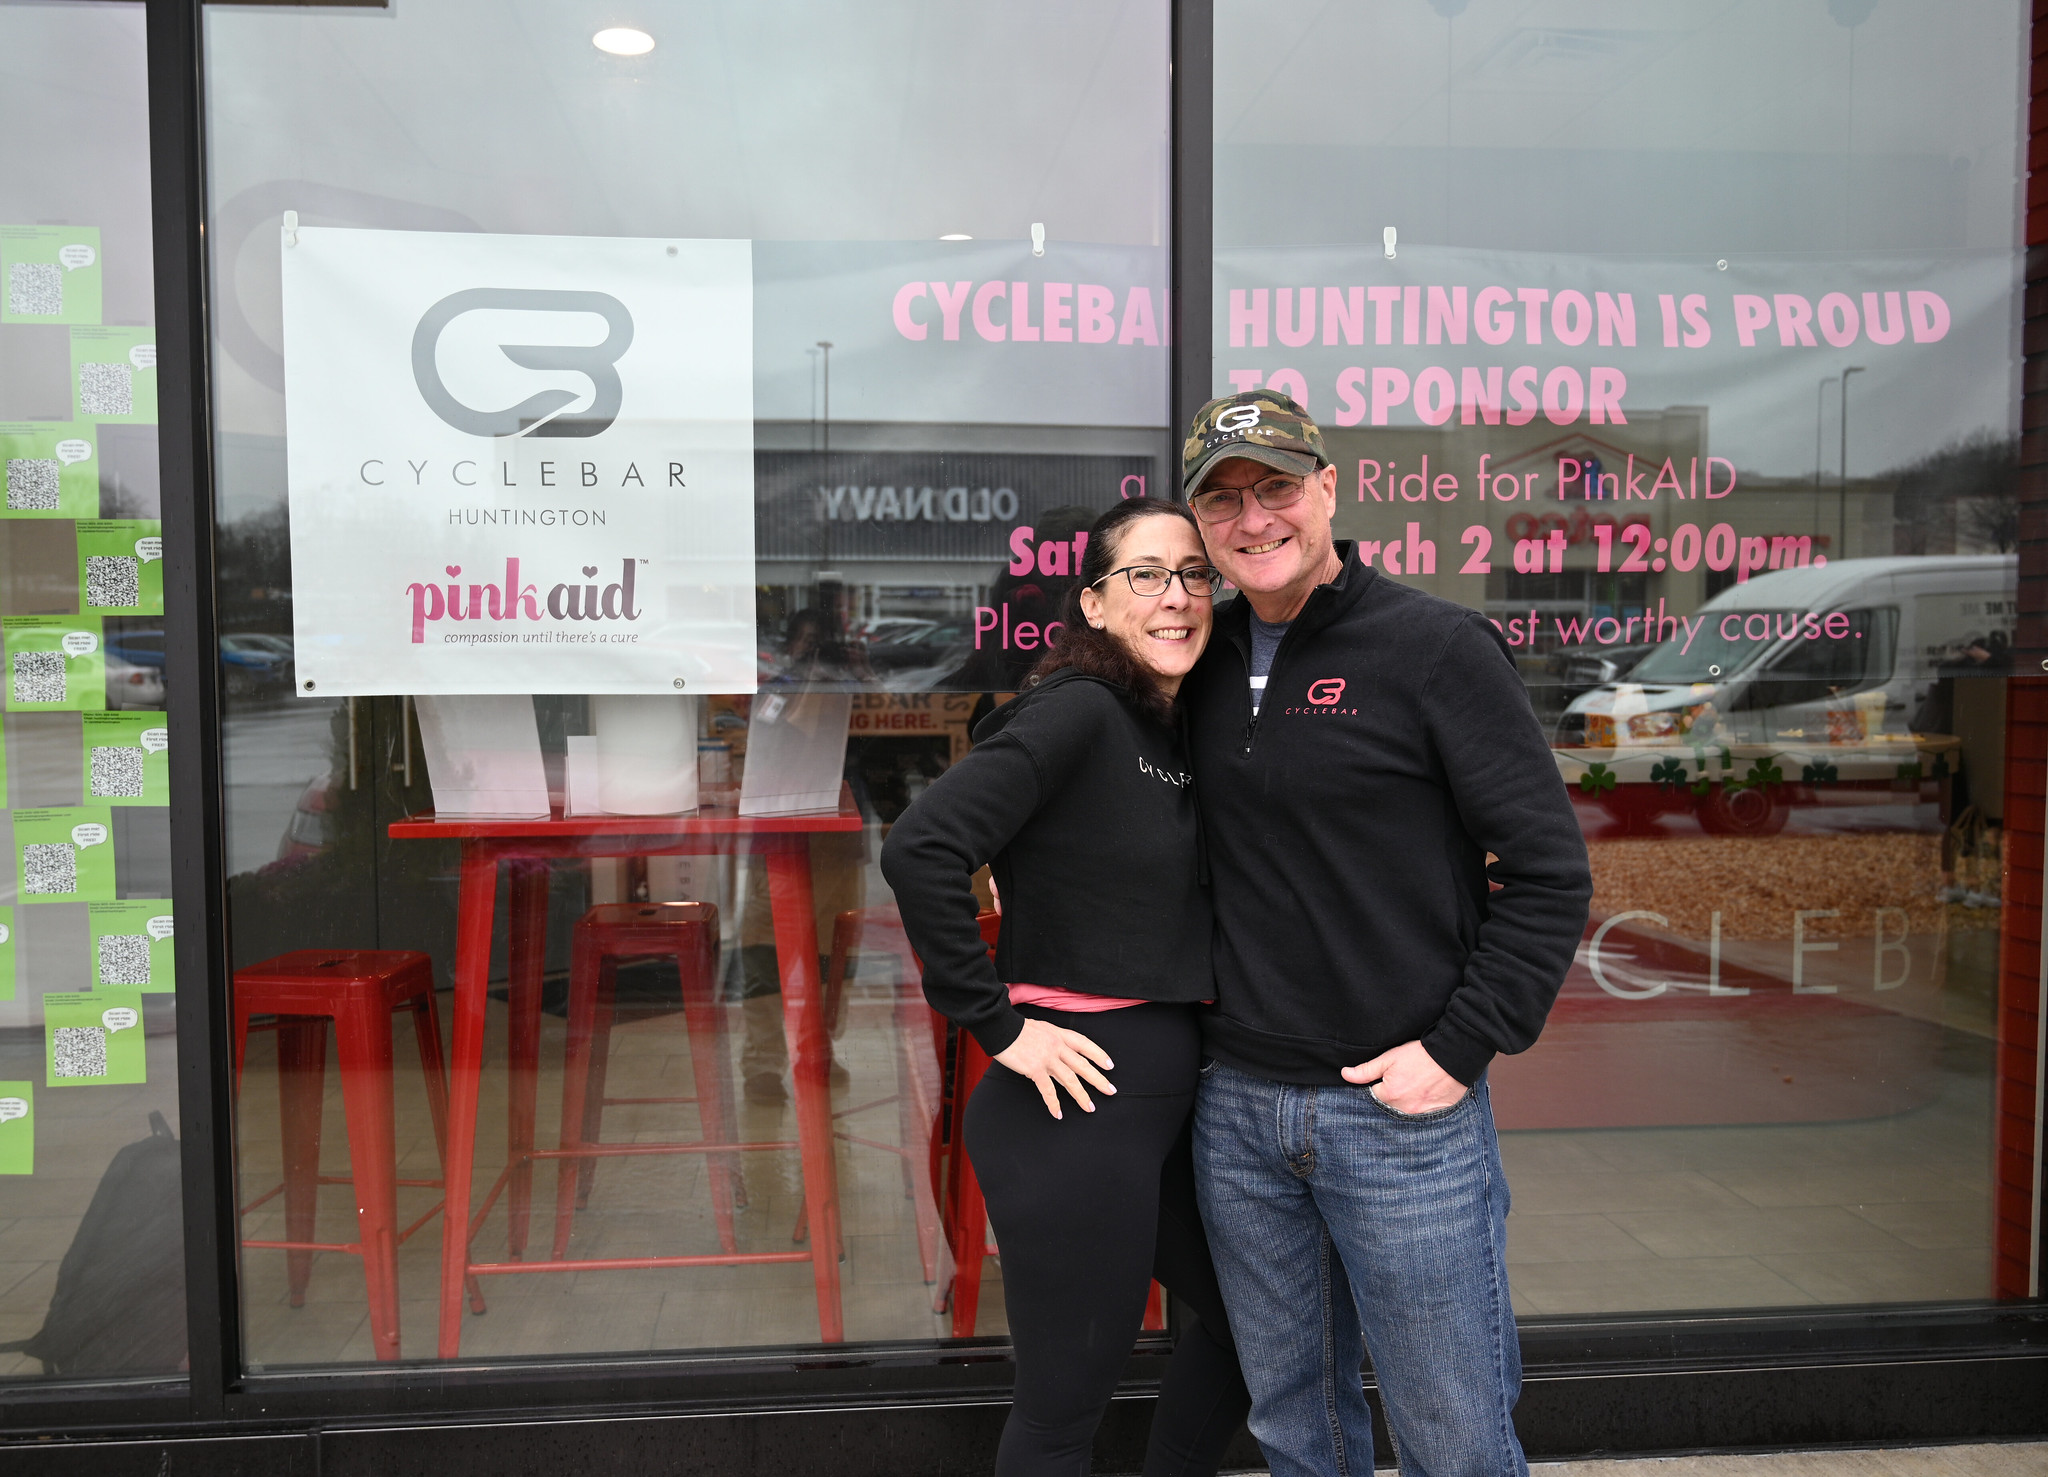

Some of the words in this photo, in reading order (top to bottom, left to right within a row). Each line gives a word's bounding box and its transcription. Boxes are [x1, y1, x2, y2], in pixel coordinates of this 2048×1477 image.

[893, 281, 1170, 347] CYCLEBA
[1230, 285, 1637, 348] HUNTINGTON
[1659, 293, 1711, 348] IS
[1733, 290, 1951, 348] PROUD
[1335, 365, 1629, 427] SPONSOR
[1206, 428, 1272, 449] CYCLEBAR
[359, 459, 686, 488] CYCLEBAR
[1120, 474, 1146, 499] a
[1358, 455, 1458, 502] Ride
[1478, 453, 1539, 501] for
[1558, 453, 1737, 501] PinkAID
[449, 508, 606, 527] HUNTINGTON
[1458, 523, 1492, 574] 2
[1513, 529, 1568, 574] at
[1594, 522, 1828, 584] 12:00pm.
[444, 632, 519, 647] compassion
[522, 631, 552, 644] until
[555, 631, 596, 644] there's
[599, 634, 607, 644] a
[610, 633, 639, 644] cure
[1555, 598, 1702, 656] worthy
[1719, 611, 1863, 642] cause.
[874, 712, 938, 730] HERE.
[1285, 706, 1358, 716] CYCLEBAR
[1587, 906, 1945, 1001] CLEB
